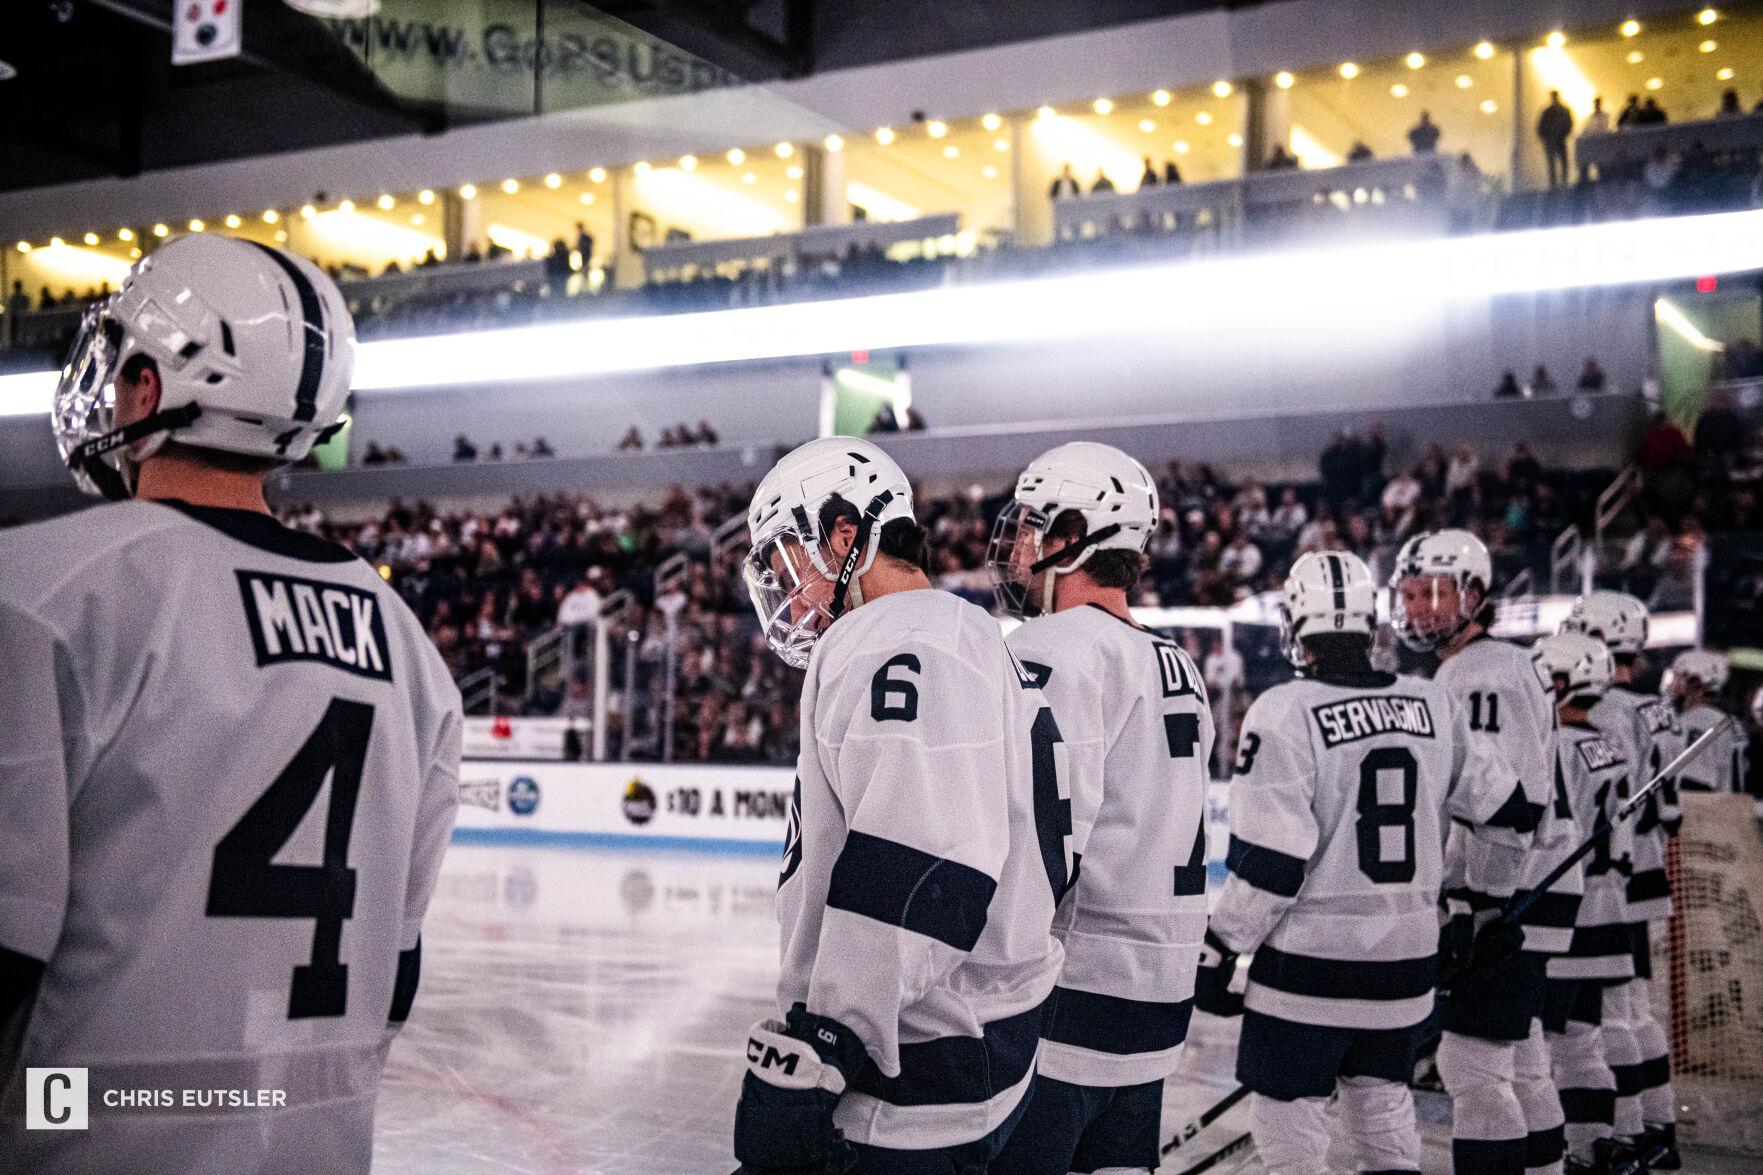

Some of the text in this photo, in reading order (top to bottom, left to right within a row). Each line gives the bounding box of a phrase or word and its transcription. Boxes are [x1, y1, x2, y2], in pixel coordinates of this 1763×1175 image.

[840, 548, 860, 585] CCM
[251, 578, 385, 672] MACK
[871, 653, 921, 722] 6
[1469, 690, 1500, 733] 11
[1318, 698, 1432, 742] SERVAGNO
[711, 788, 724, 816] A
[1356, 747, 1418, 884] 8
[205, 696, 375, 1020] 4
